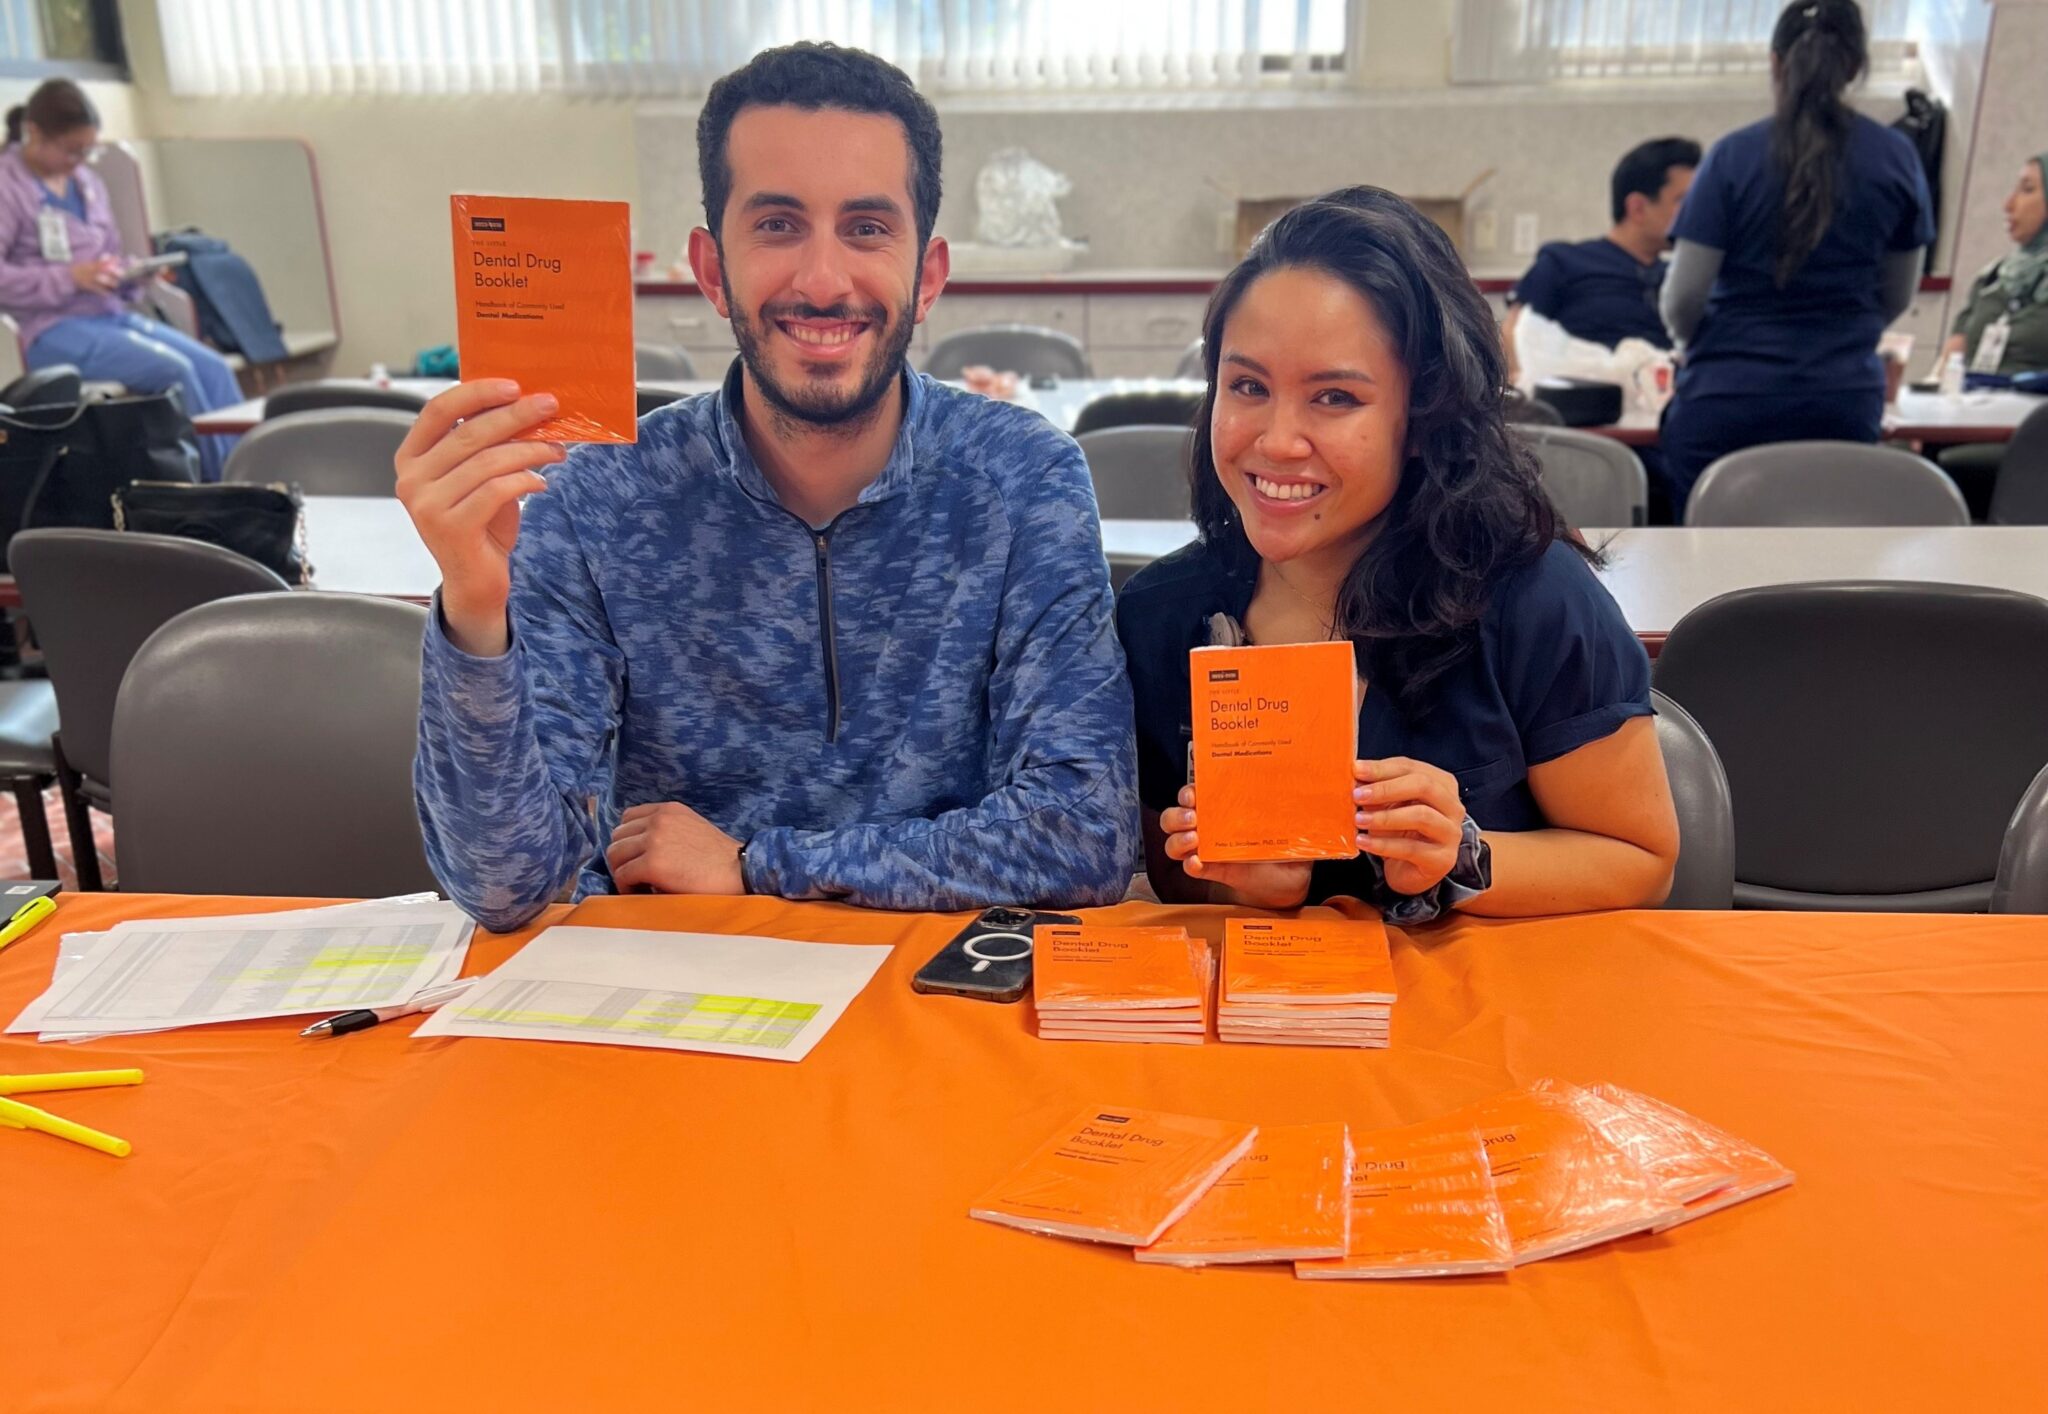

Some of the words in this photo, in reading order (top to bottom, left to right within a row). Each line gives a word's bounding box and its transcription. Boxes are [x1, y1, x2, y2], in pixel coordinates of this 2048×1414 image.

[474, 251, 520, 268] Dental
[526, 253, 561, 273] Drug
[474, 271, 529, 288] Booklet
[1210, 697, 1252, 713] Dental
[1257, 697, 1289, 713] Drug
[1211, 715, 1259, 731] Booklet
[1098, 941, 1129, 949] Drug
[1290, 935, 1322, 943] Drug
[1070, 1135, 1124, 1149] Booklet
[1080, 1127, 1129, 1140] Dental
[1128, 1133, 1164, 1147] Drug
[1365, 1160, 1405, 1169] Drug
